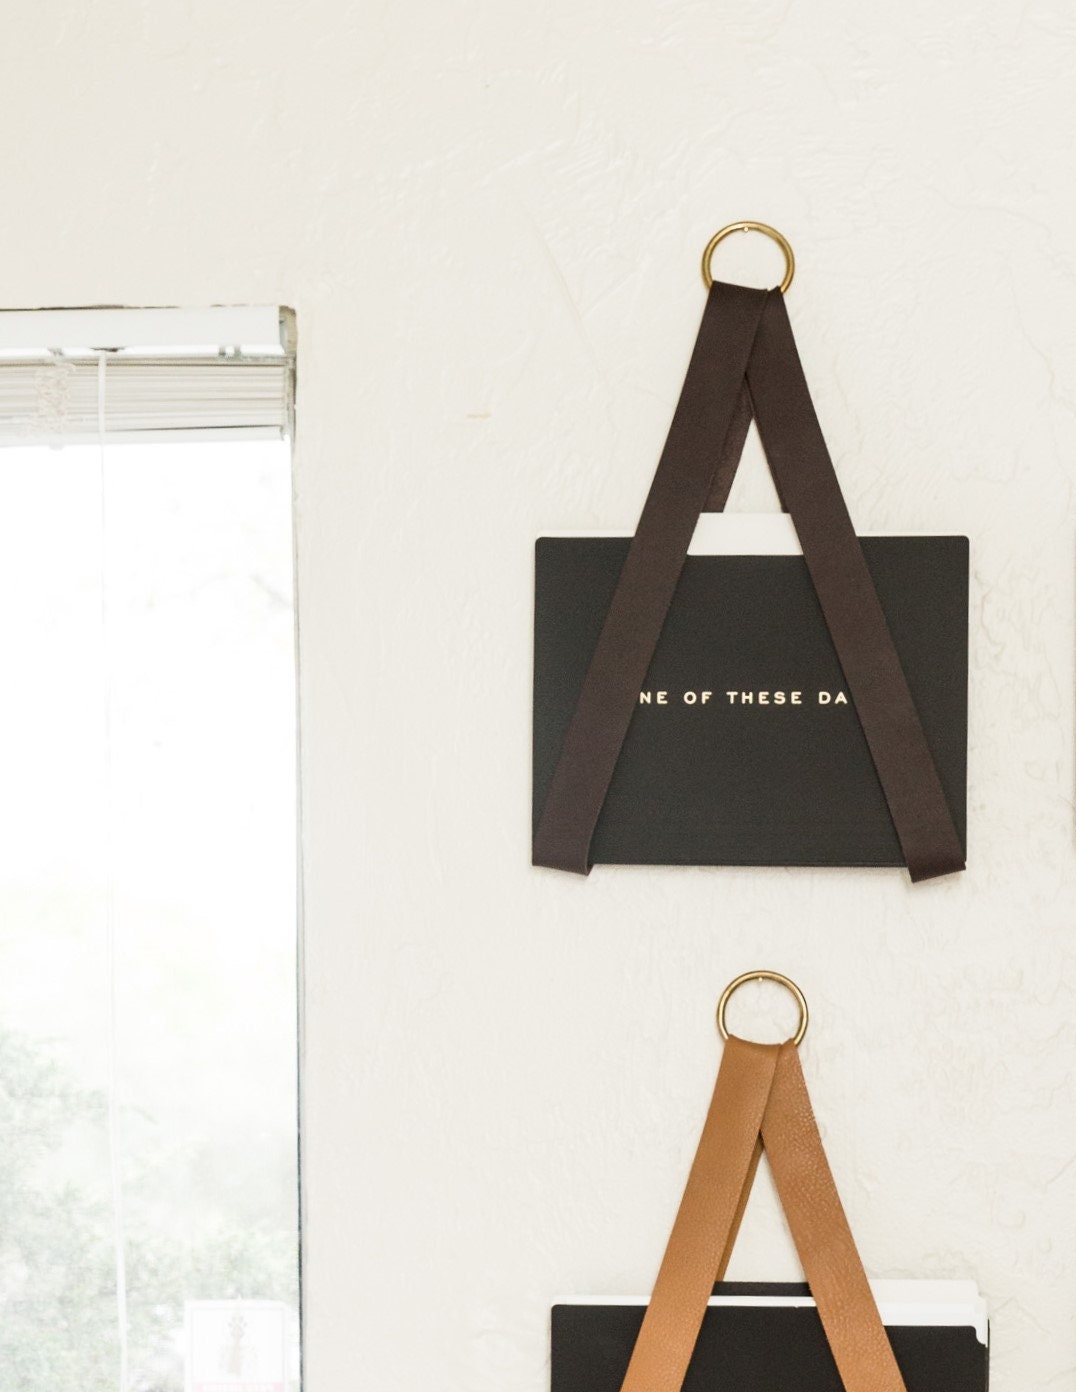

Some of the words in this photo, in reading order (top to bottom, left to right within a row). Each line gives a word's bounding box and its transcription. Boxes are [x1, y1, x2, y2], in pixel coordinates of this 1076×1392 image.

[639, 691, 668, 704] NE
[683, 691, 712, 704] OF
[726, 691, 802, 704] THESE
[818, 691, 848, 704] DA
